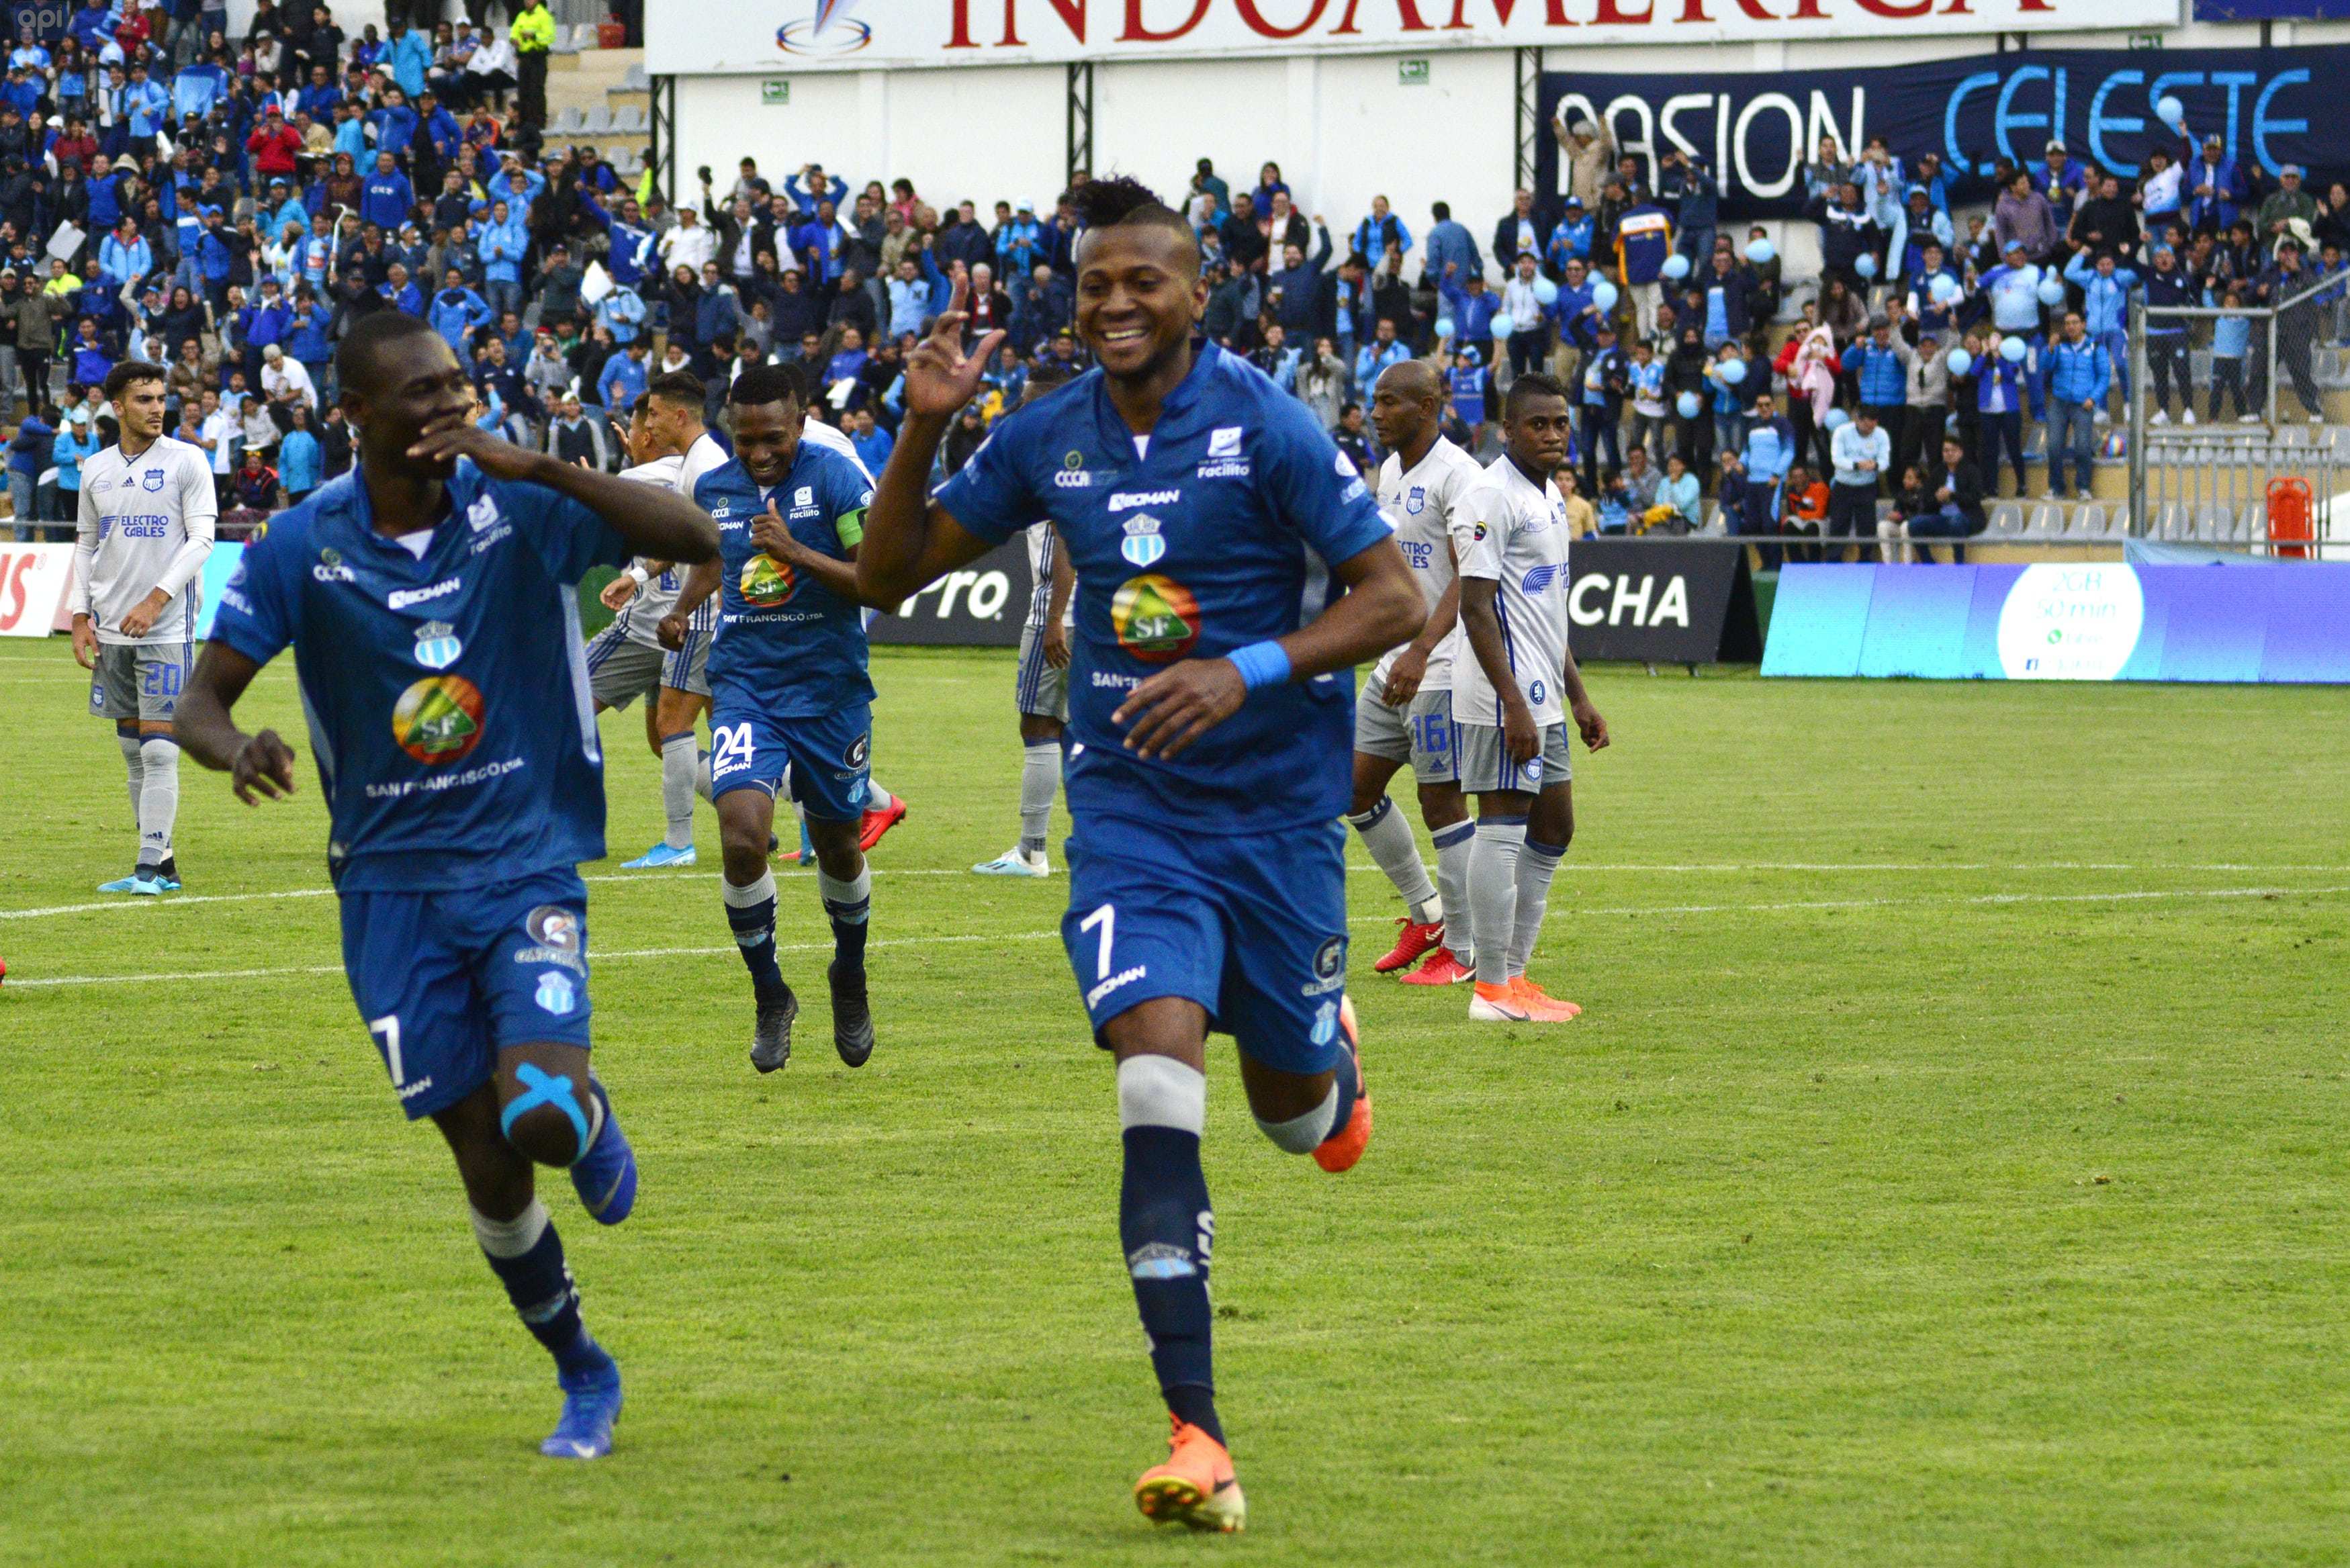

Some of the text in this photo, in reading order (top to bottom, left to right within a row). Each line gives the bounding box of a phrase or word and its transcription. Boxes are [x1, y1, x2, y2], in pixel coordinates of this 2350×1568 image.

[1557, 65, 2310, 198] PASION CELESTE
[121, 515, 169, 526] ELECTRO
[790, 509, 819, 520] Facilito
[124, 526, 165, 537] CABLES
[718, 521, 743, 531] OMAN
[1397, 540, 1433, 556] CTRO
[755, 580, 778, 595] SF
[723, 614, 737, 624] SAN
[739, 613, 805, 624] FRANCISCO
[1134, 616, 1170, 639] SF
[144, 663, 181, 696] 20
[1092, 671, 1124, 688] SAN
[1412, 713, 1447, 753] 16
[713, 723, 757, 771] 24
[366, 782, 400, 798] SAN
[404, 762, 501, 796] FRANCISCO
[1080, 903, 1116, 980] 7
[370, 1014, 405, 1087] 7
